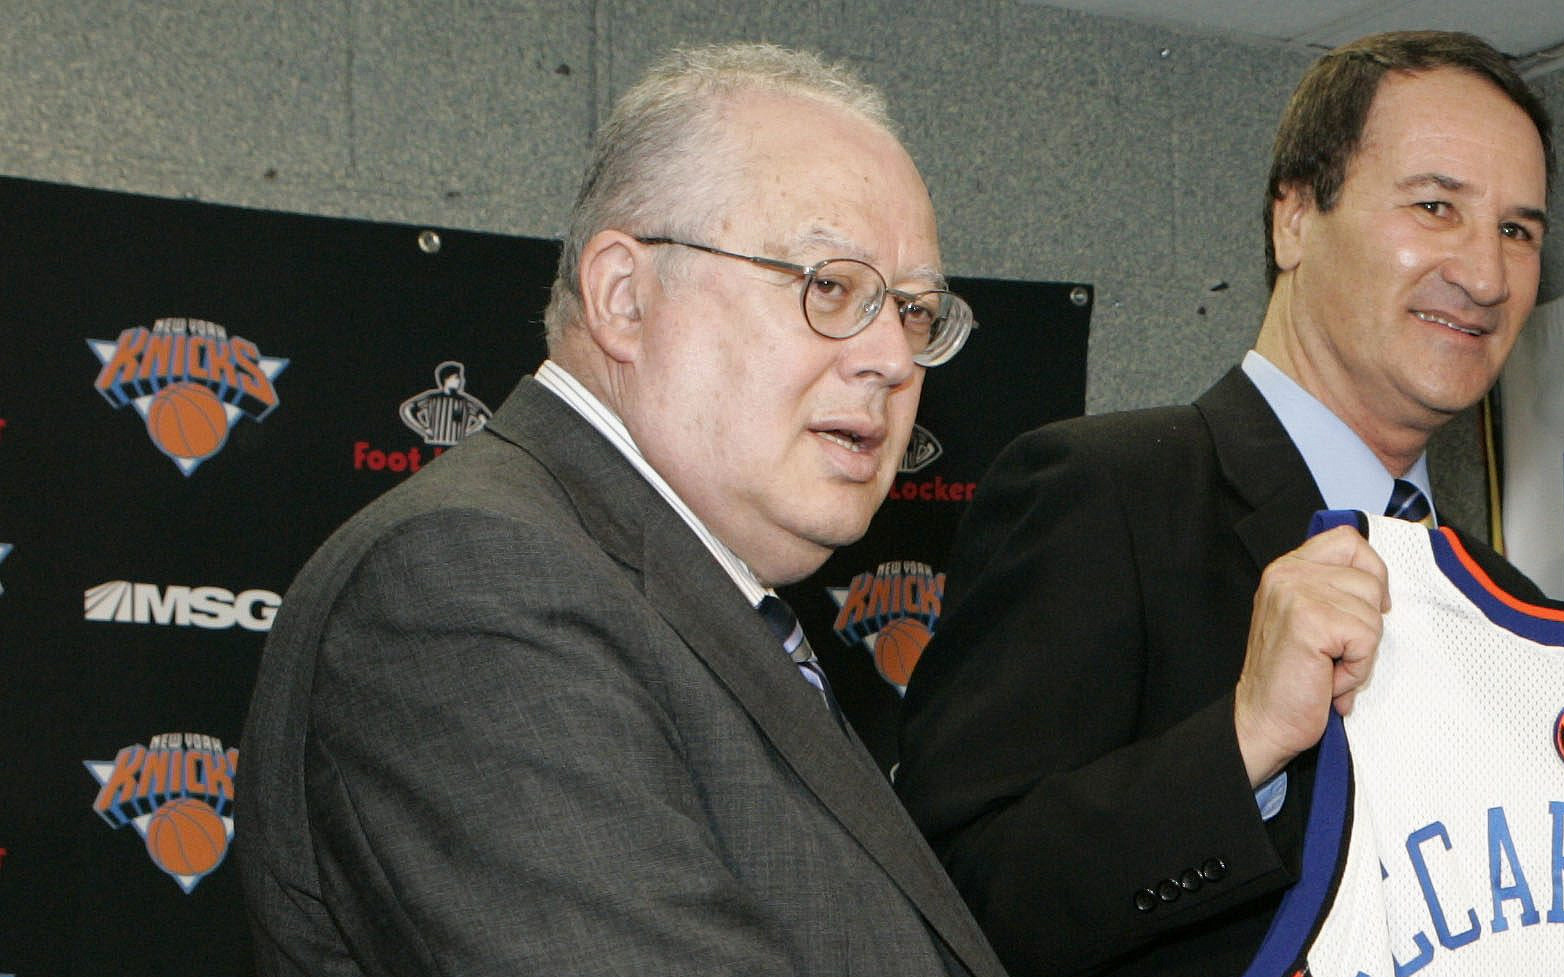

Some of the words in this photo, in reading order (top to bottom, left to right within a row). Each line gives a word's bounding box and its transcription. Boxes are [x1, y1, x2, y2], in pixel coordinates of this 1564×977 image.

[153, 318, 187, 335] NEW
[189, 318, 227, 340] YORK
[96, 326, 279, 408] KNICKS
[354, 441, 421, 472] Foot
[876, 561, 901, 577] NEW
[904, 560, 933, 577] YORK
[134, 582, 282, 632] MSG
[151, 733, 182, 749] NEW
[184, 733, 222, 751] YORK
